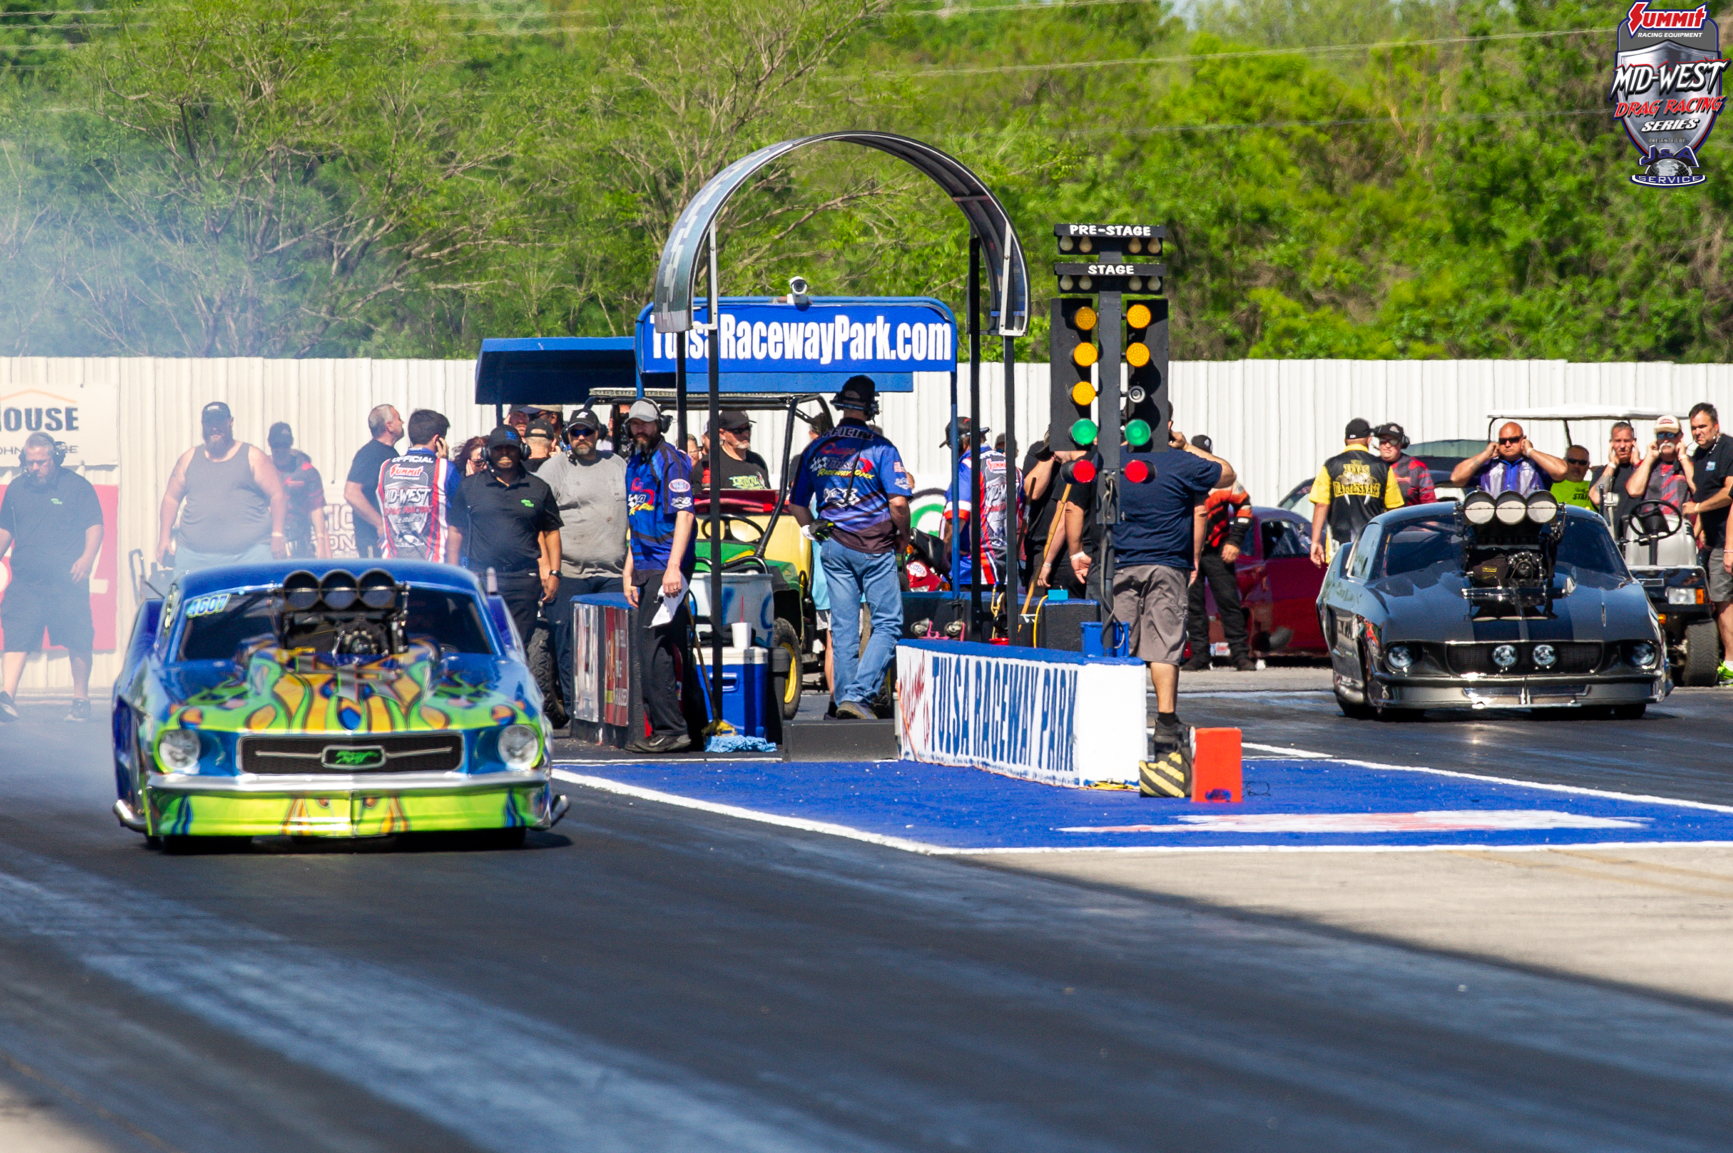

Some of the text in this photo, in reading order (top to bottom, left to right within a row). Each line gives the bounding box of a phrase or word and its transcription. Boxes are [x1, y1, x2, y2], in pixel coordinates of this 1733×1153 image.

[1069, 224, 1151, 236] PRE-STAGE
[1088, 264, 1135, 275] STAGE
[650, 314, 951, 364] TusRacewayPark.com
[0, 406, 79, 431] OUSE
[932, 655, 1078, 772] TULSA RACEWAY PARK
